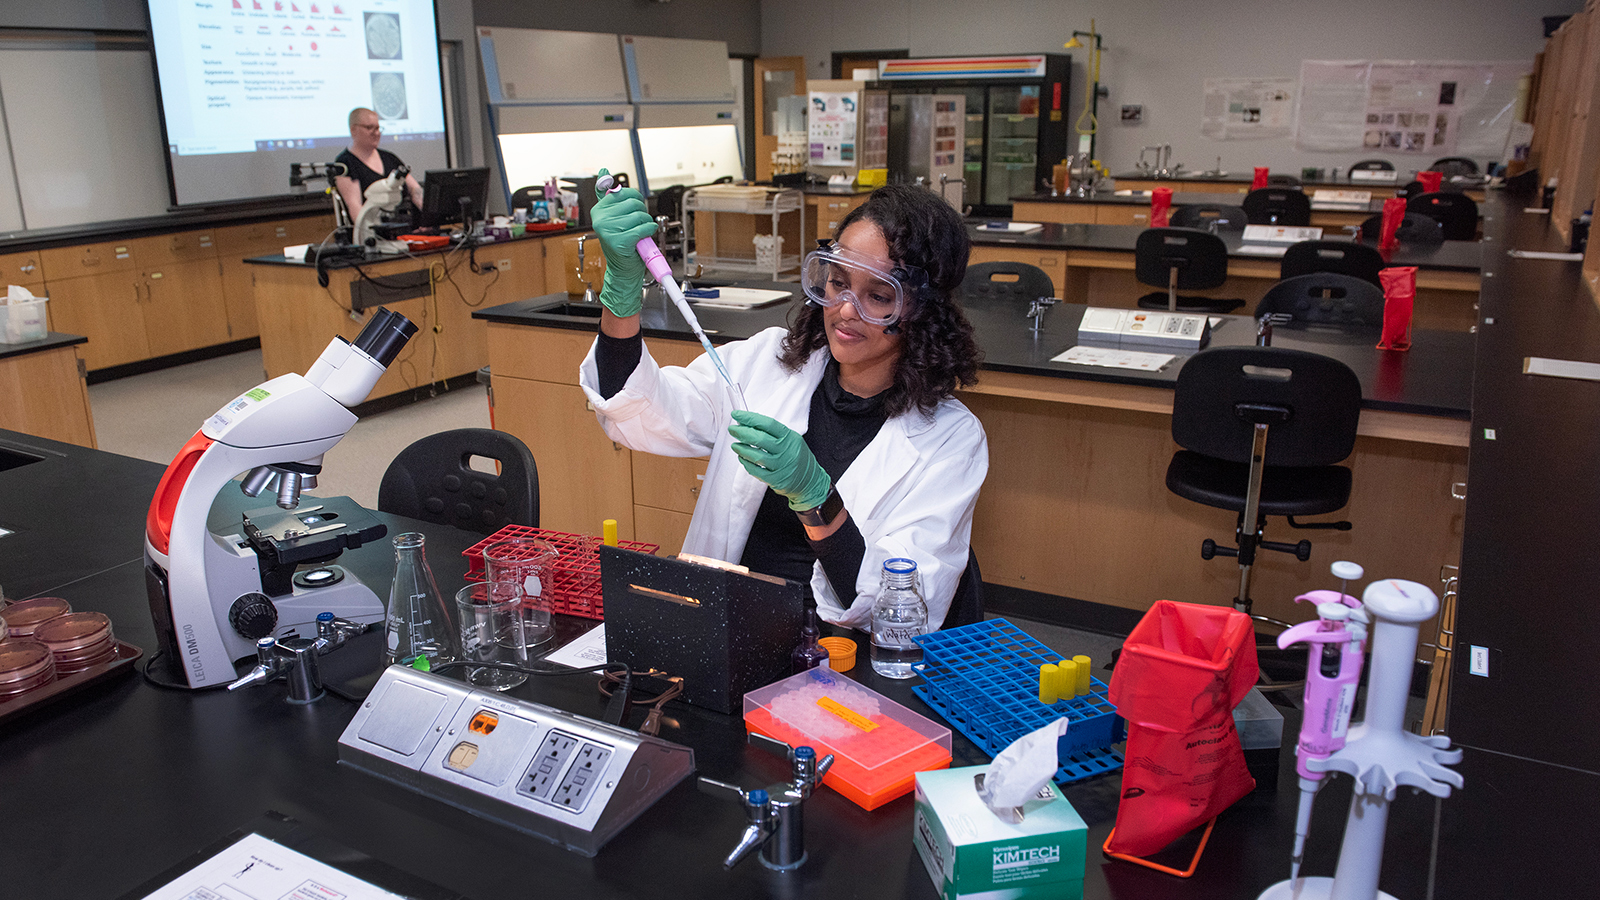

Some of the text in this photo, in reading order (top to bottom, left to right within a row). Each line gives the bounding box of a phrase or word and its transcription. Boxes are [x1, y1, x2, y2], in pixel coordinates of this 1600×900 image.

[183, 624, 206, 682] LEICA DM500
[993, 845, 1060, 865] KIMTECH
